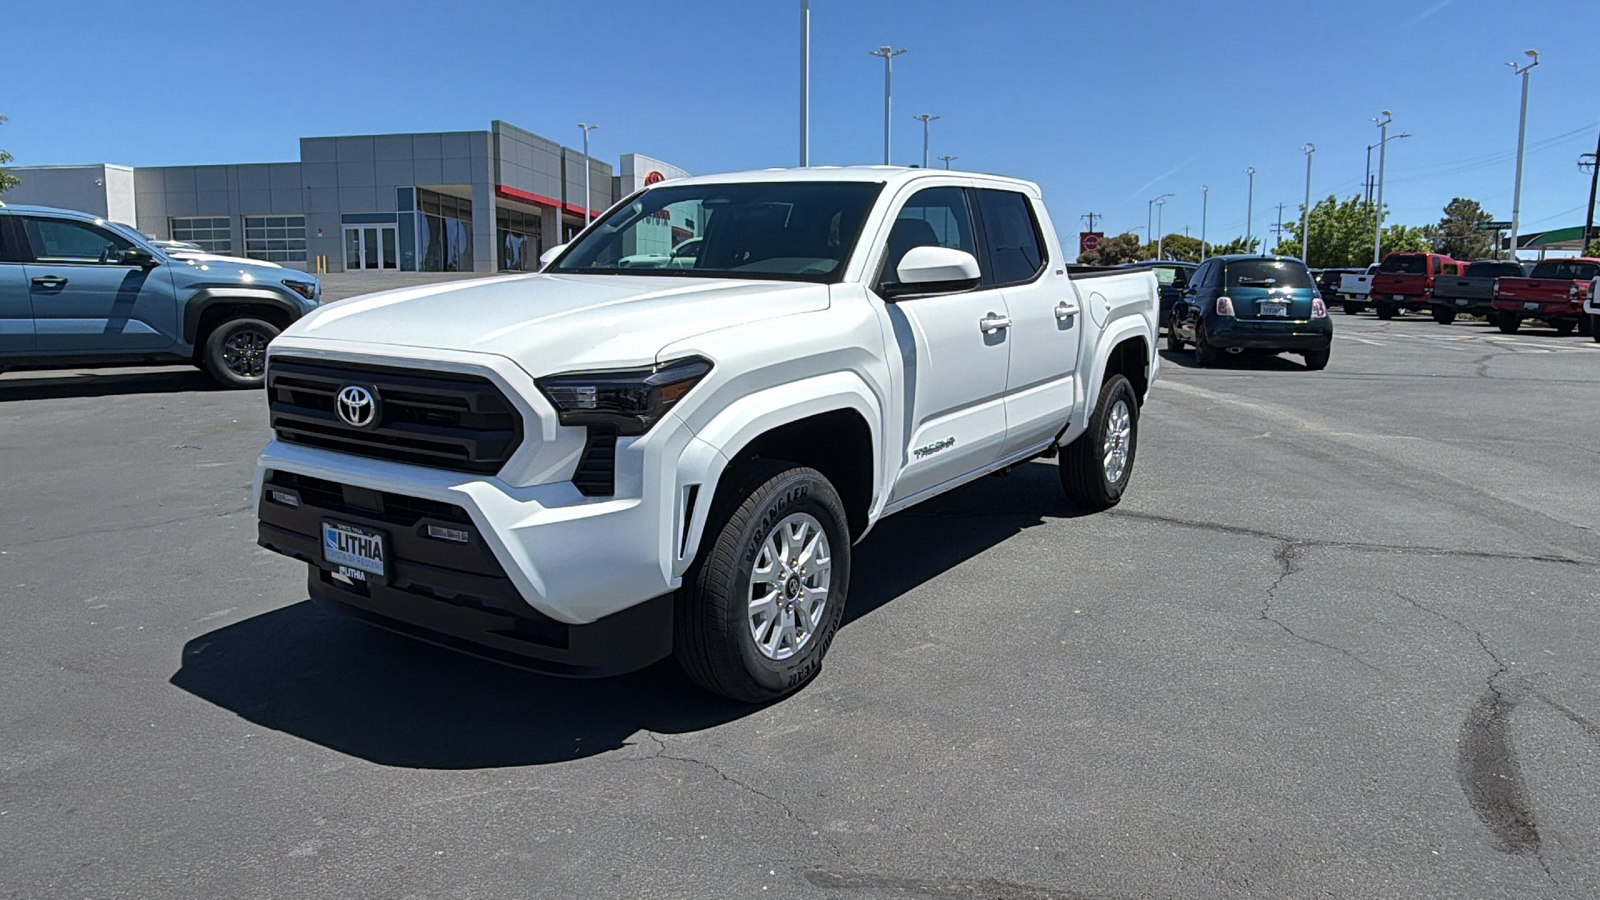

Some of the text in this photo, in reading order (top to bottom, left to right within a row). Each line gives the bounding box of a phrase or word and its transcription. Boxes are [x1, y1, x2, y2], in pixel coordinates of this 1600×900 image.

[913, 437, 955, 459] TACOMA
[744, 485, 809, 562] WRANGLER
[337, 531, 383, 562] LITHIA
[348, 554, 357, 563] OF
[356, 557, 383, 569] REDDING
[344, 567, 366, 581] LITHIA
